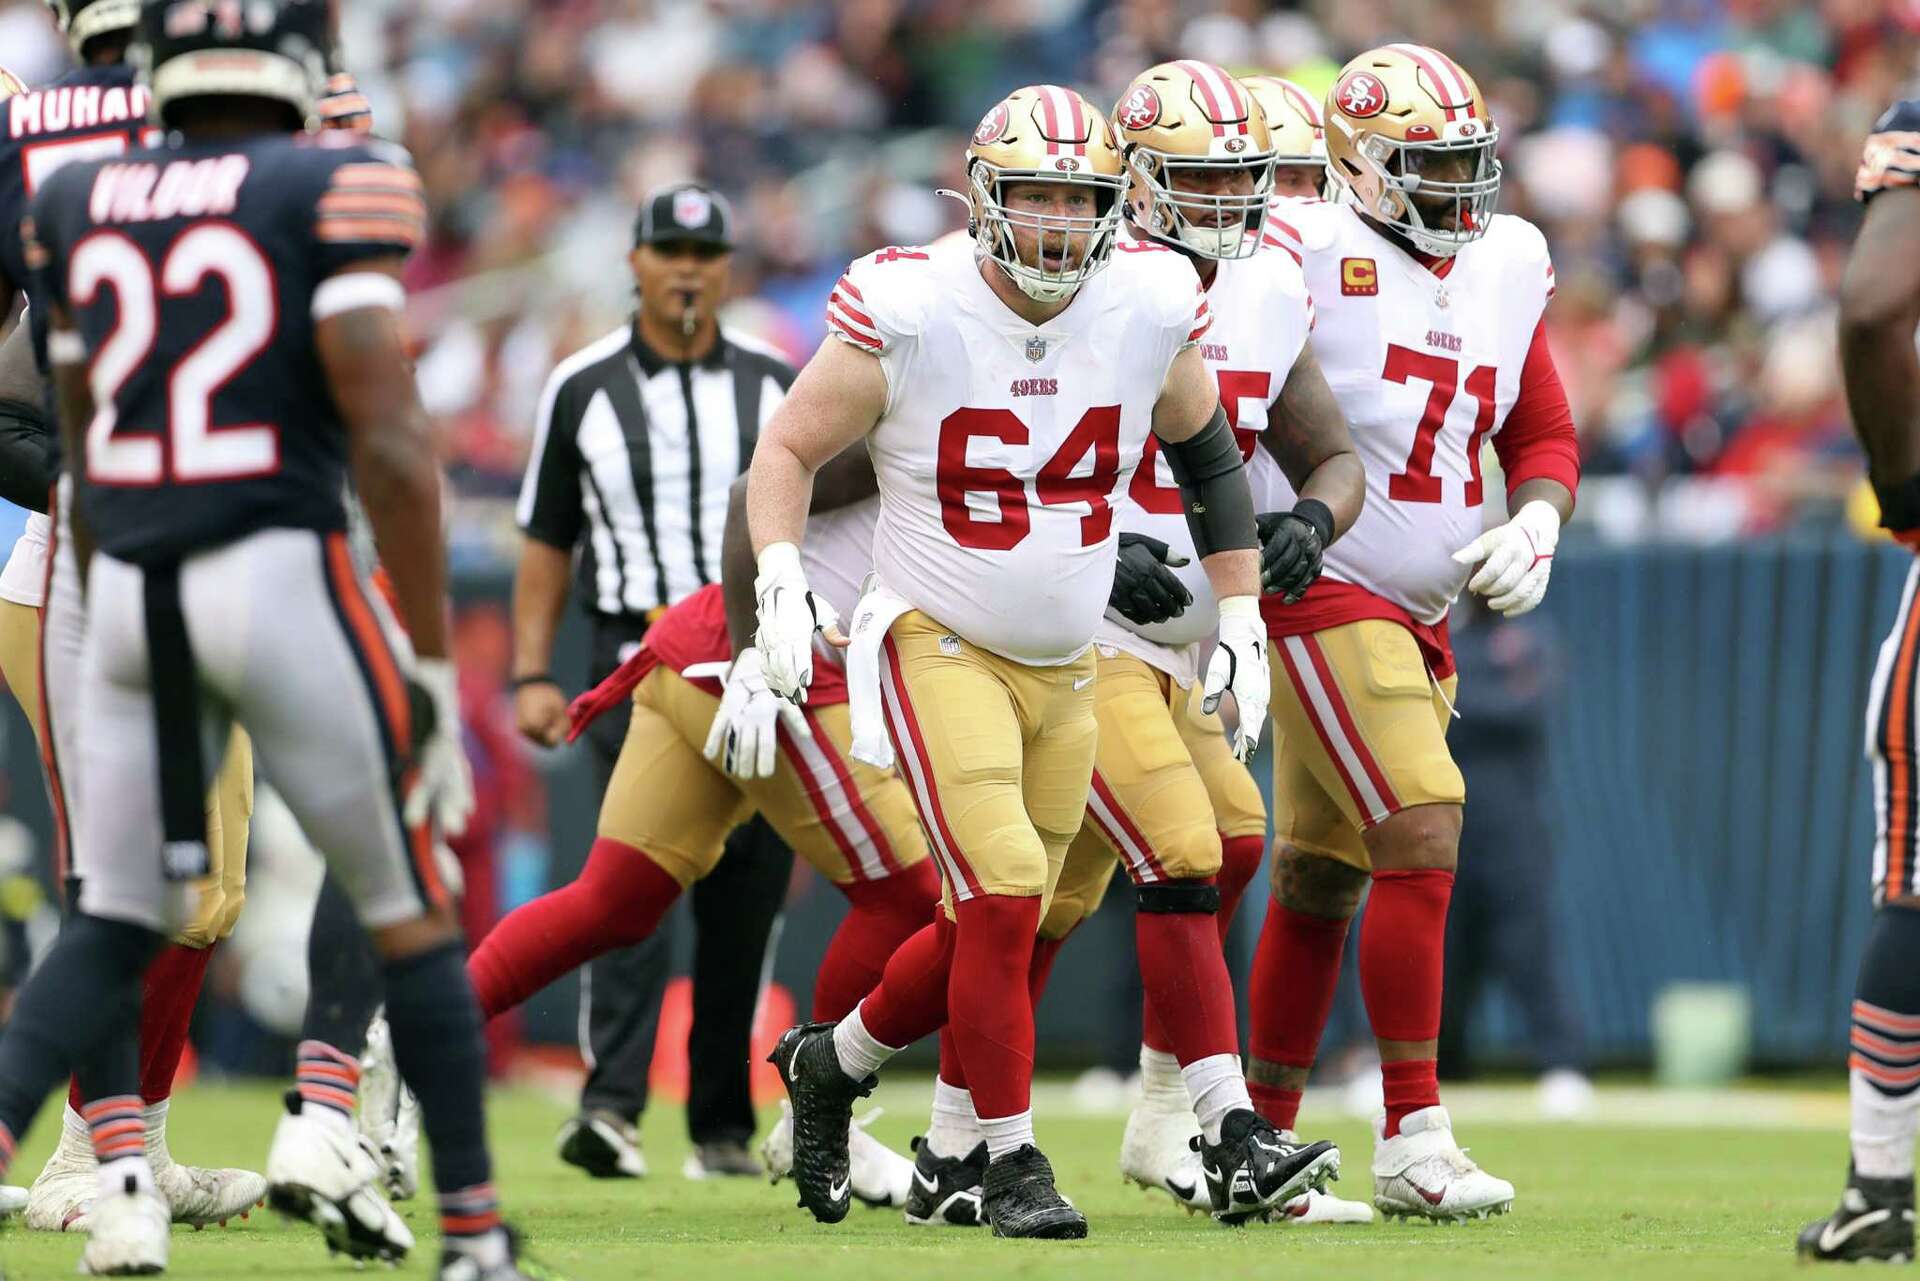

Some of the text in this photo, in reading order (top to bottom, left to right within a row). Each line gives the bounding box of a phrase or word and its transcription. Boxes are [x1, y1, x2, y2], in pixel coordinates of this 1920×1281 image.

[69, 219, 281, 485] 22
[1010, 378, 1058, 397] 49ERS
[1425, 329, 1462, 352] 49ERS
[936, 403, 1121, 551] 64
[1382, 342, 1498, 508] 71
